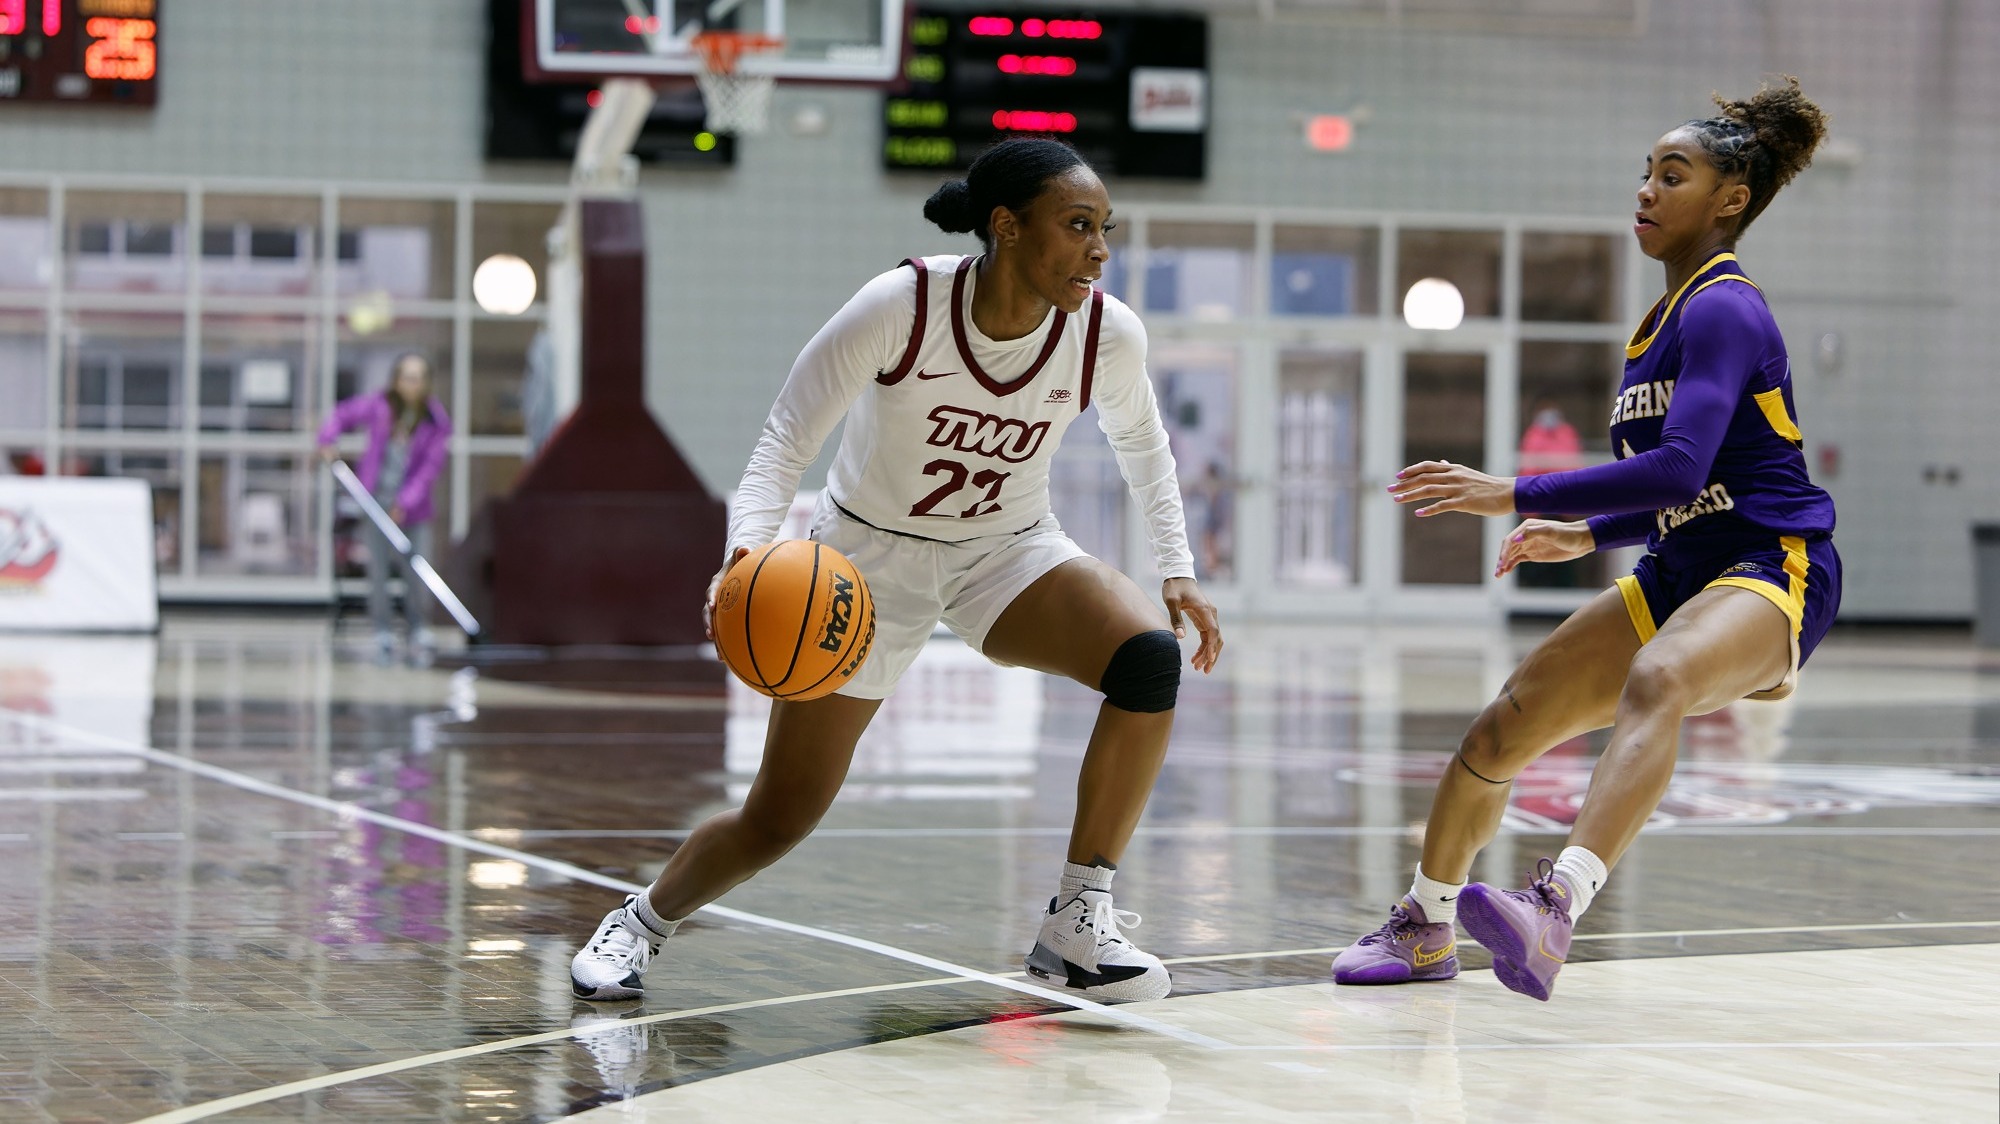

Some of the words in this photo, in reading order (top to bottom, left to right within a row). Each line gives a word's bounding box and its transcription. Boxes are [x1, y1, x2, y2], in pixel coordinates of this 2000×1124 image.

[926, 404, 1052, 464] TWU
[908, 458, 1012, 518] 22
[818, 572, 854, 653] NCAA
